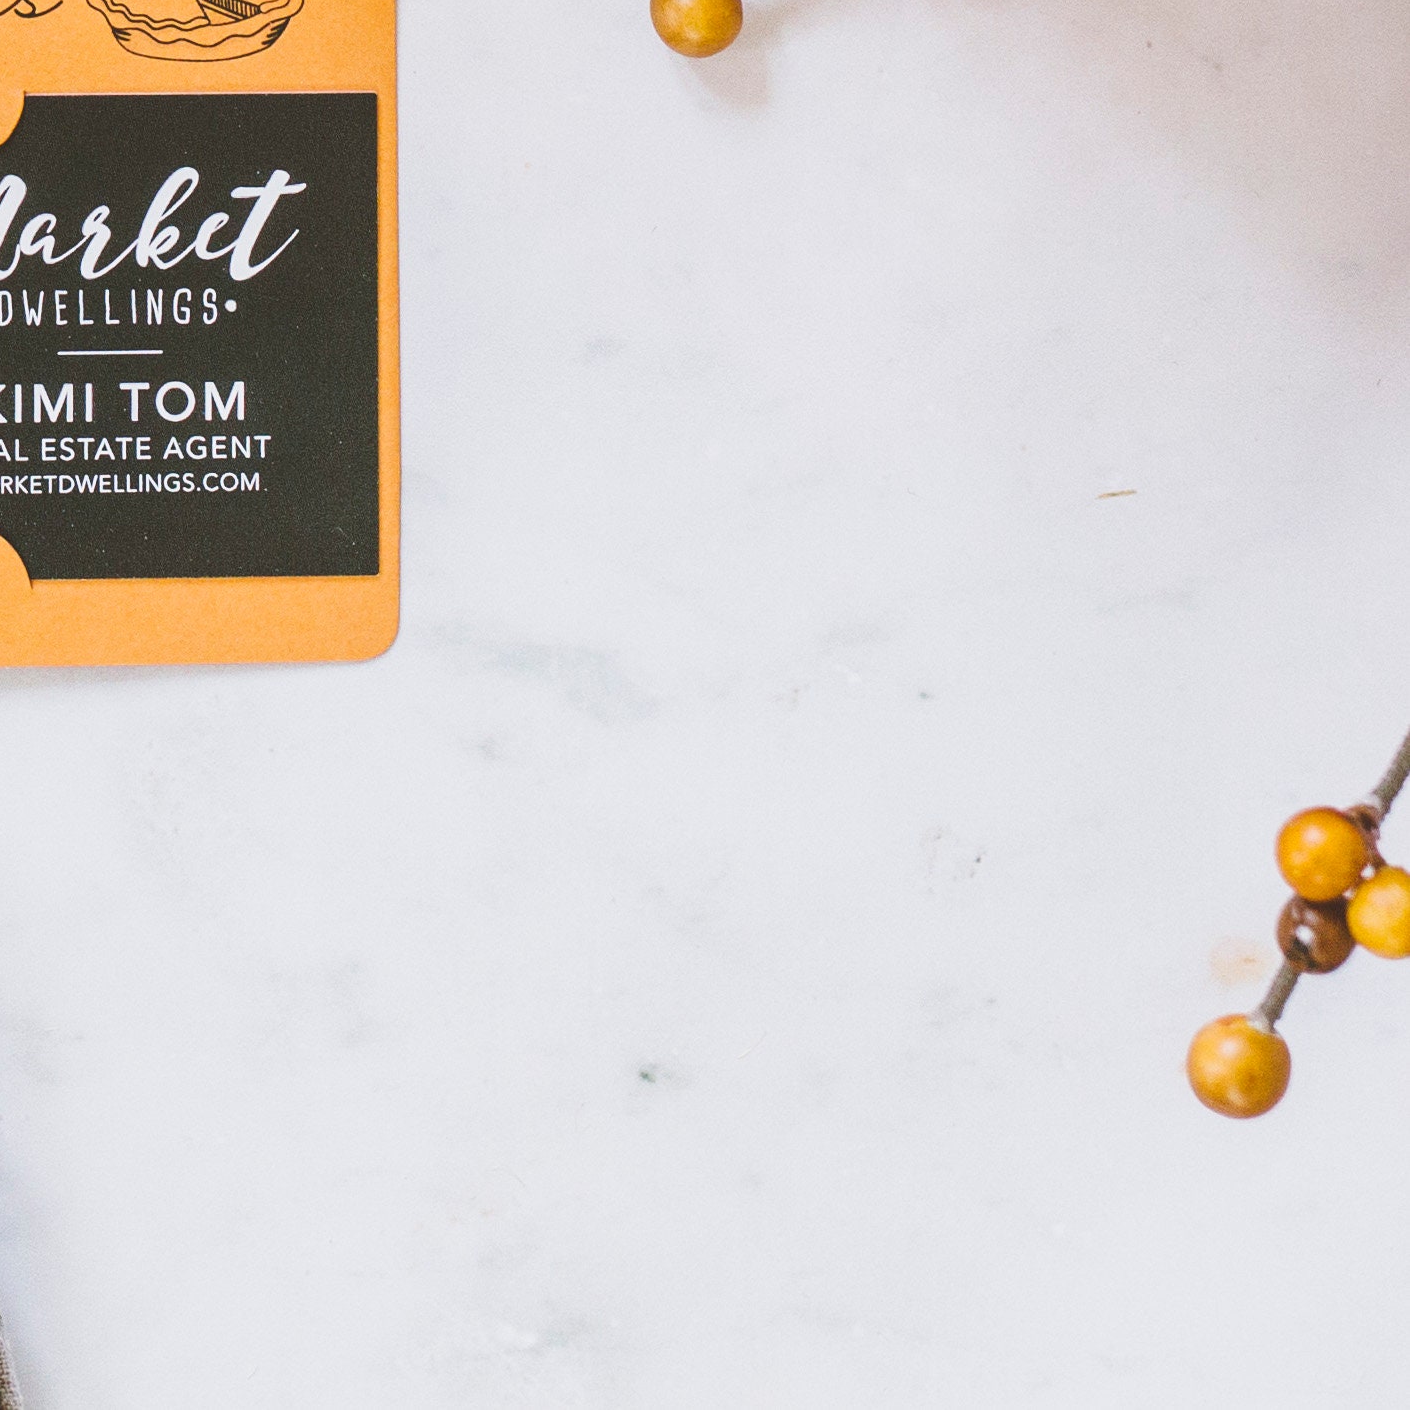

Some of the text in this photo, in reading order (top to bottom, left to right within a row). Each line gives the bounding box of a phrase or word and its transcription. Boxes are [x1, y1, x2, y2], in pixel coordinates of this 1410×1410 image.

[119, 380, 245, 423] TOM
[41, 436, 152, 462] ESTATE
[162, 435, 272, 460] AGENT
